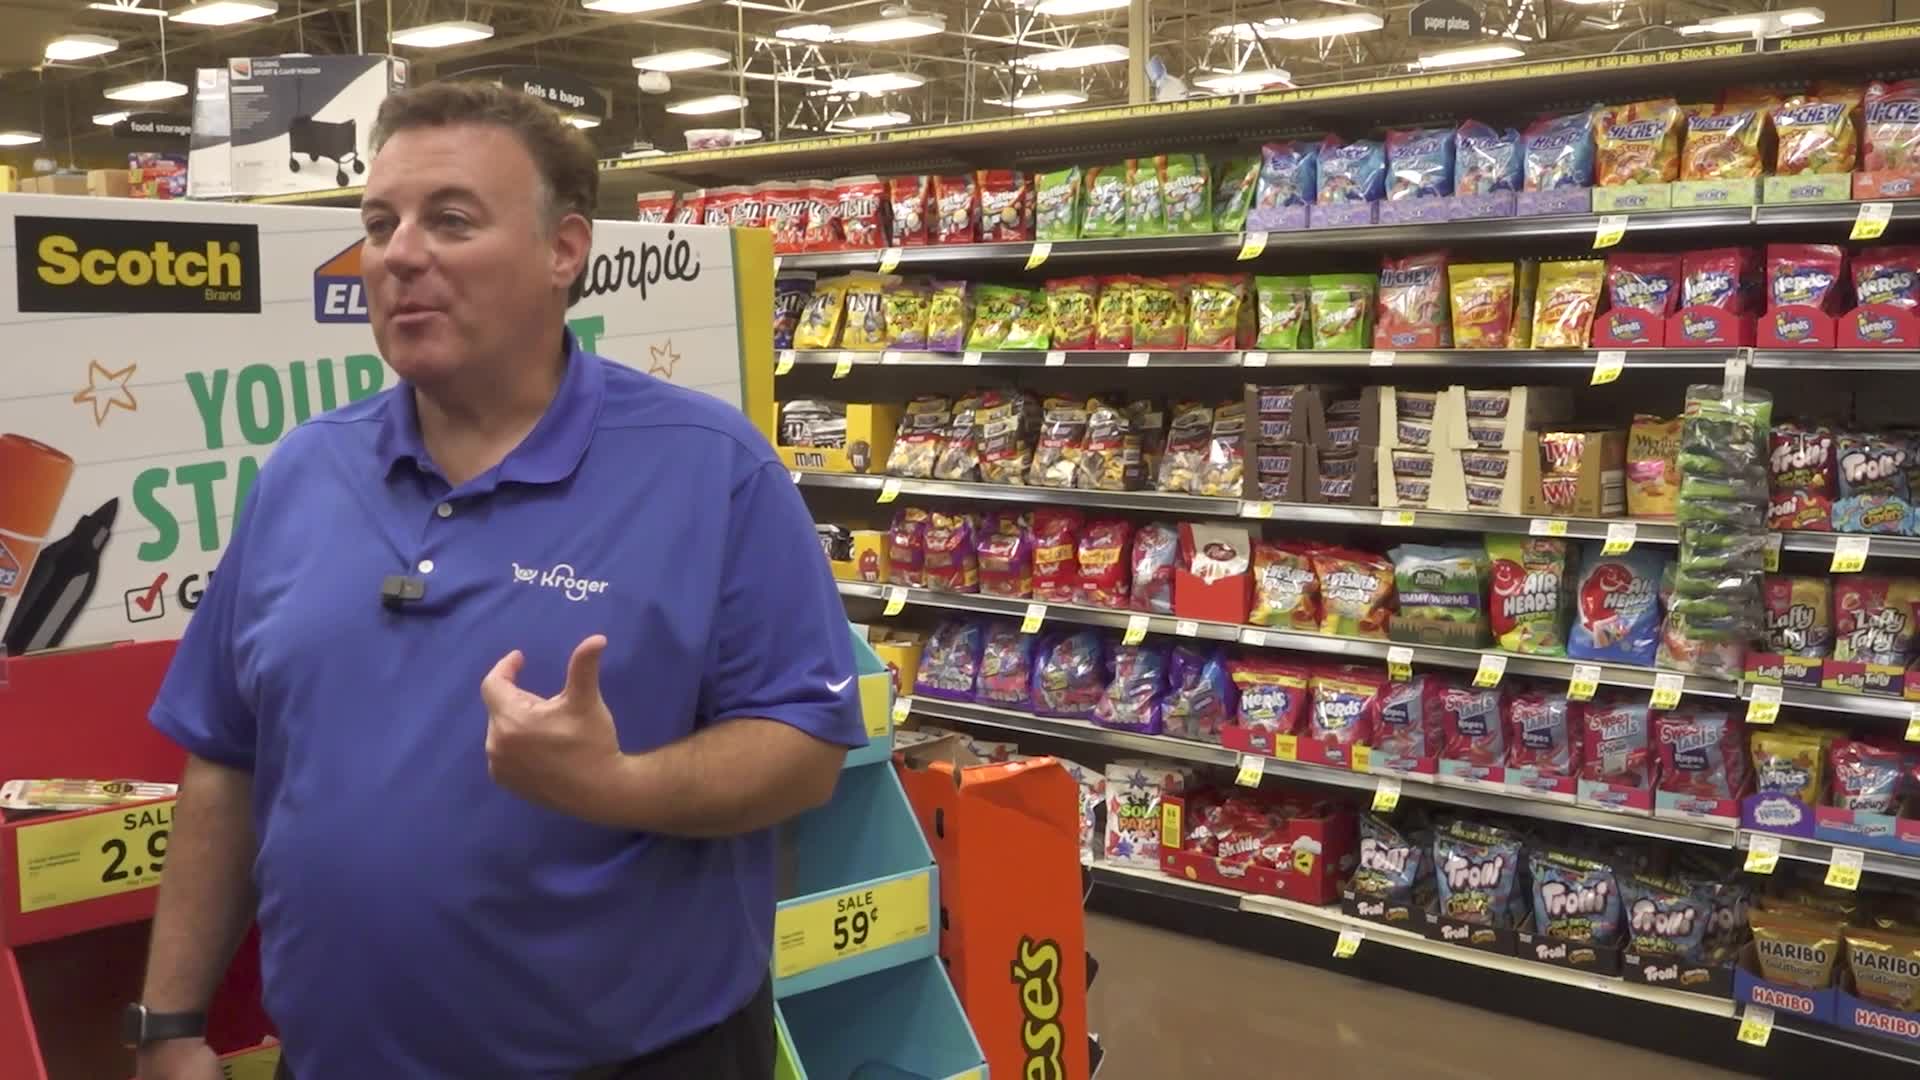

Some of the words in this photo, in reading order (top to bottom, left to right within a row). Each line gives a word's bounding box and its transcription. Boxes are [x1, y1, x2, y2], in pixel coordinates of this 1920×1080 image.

[1424, 16, 1446, 31] paper
[1447, 16, 1470, 32] plates
[1780, 38, 1819, 50] Please
[1820, 34, 1842, 46] ask
[1844, 31, 1862, 43] for
[1863, 25, 1920, 41] assistanc
[1658, 50, 1680, 64] Top
[1681, 48, 1713, 60] Stock
[1714, 43, 1745, 57] Shelf
[523, 81, 546, 98] foils
[548, 88, 558, 100] &
[559, 90, 585, 107] bags
[1865, 102, 1920, 122] HI-CHE
[131, 121, 154, 132] food
[155, 124, 192, 136] storage
[37, 235, 241, 286] Scotch
[584, 228, 700, 301] arpie
[1379, 268, 1440, 288] HI-CHEW
[204, 288, 241, 301] Brand
[185, 354, 385, 450] YOUR
[1841, 450, 1907, 482] Trolli
[132, 455, 261, 562] STA
[1768, 496, 1798, 518] rolli
[540, 564, 608, 601] Kroger
[1524, 573, 1559, 594] AIR
[1400, 593, 1427, 603] UMMY
[1503, 592, 1557, 617] HEADS
[1767, 604, 1815, 630] Laffy
[1854, 608, 1906, 632] Laffy
[1849, 631, 1894, 653] Taffy
[1757, 664, 1783, 679] Laffy
[1783, 663, 1808, 678] Taffy
[1837, 673, 1864, 688] Laffy
[1864, 672, 1891, 687] Taffy
[101, 829, 168, 882] 2.9
[1444, 856, 1504, 888] Trolli
[836, 890, 873, 912] SALE
[1541, 880, 1608, 915] Trolli
[833, 906, 879, 951] 59¢
[1632, 899, 1696, 936] Trolli
[1441, 925, 1469, 940] Trolli
[1535, 944, 1567, 961] Trolli
[1760, 940, 1826, 964] HARIBO
[1854, 950, 1920, 978] HARIBO
[1644, 964, 1678, 982] Trolli
[1012, 935, 1064, 1080] ese's
[1752, 985, 1814, 1015] HARIBO
[1855, 1008, 1920, 1038] HARIBO
